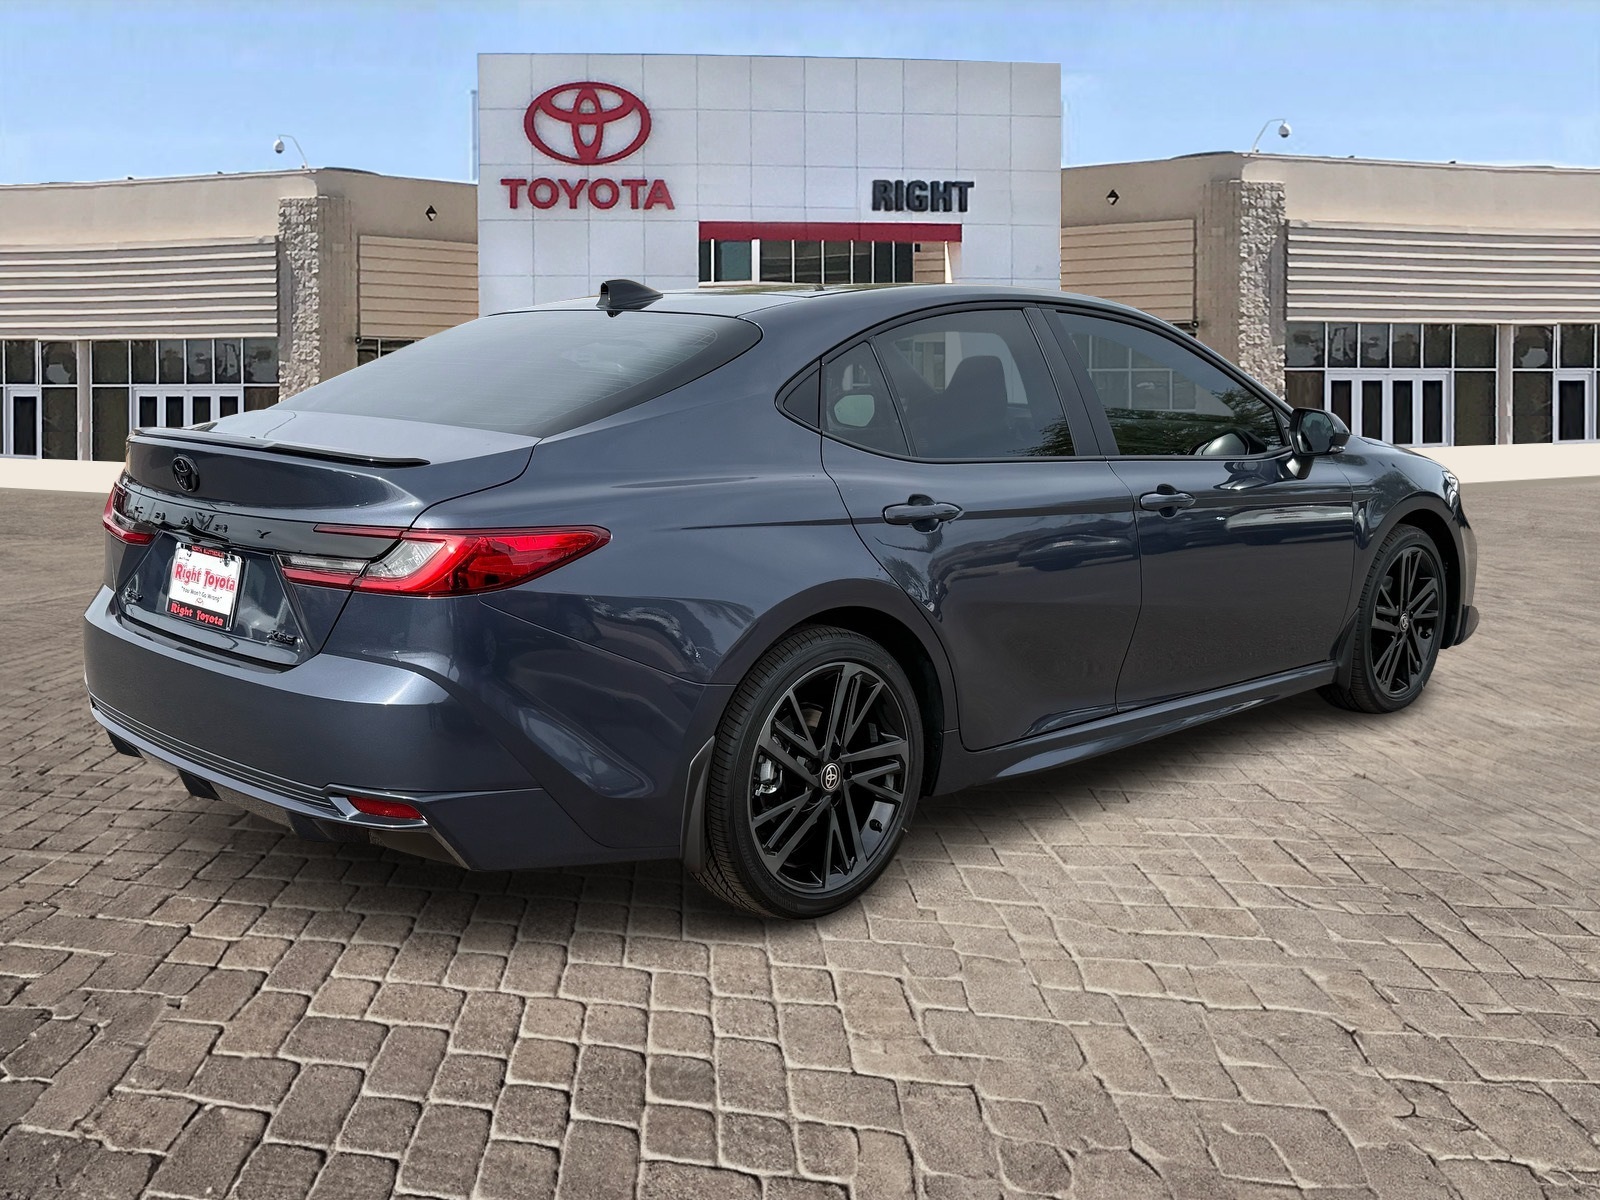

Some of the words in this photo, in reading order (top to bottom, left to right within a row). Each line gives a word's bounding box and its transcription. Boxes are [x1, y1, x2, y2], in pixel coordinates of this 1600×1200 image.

[500, 178, 675, 210] TOYOTA
[872, 179, 975, 212] RIGHT
[174, 563, 202, 585] Right
[203, 570, 236, 593] Toyota
[170, 602, 193, 617] Right
[196, 609, 224, 626] Toyota
